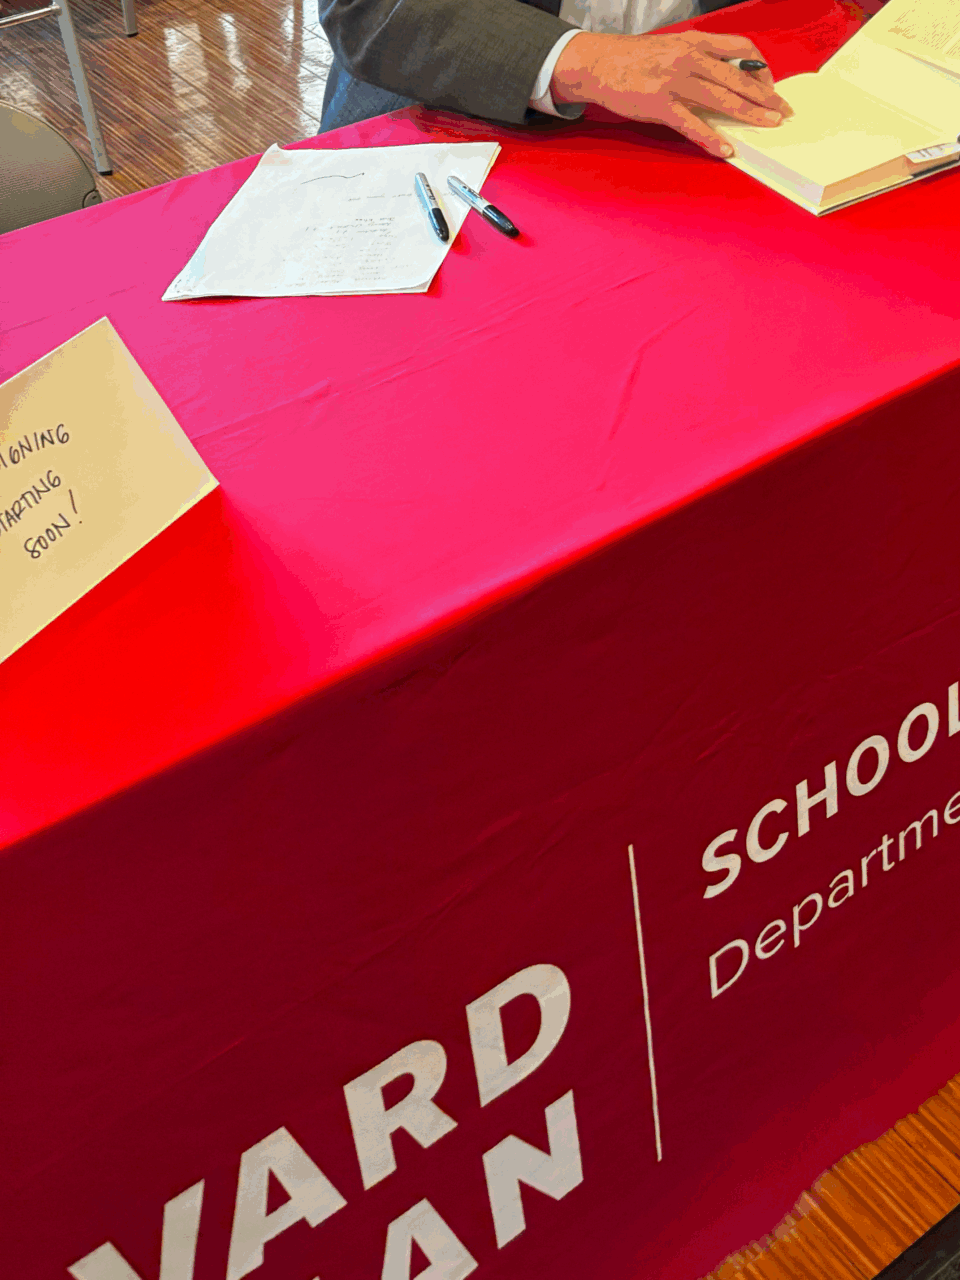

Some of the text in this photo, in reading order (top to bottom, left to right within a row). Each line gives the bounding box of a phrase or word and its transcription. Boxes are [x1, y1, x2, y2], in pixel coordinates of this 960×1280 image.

[0, 423, 70, 468] IGNING
[0, 470, 61, 535] TARTING
[311, 1089, 583, 1280] AN
